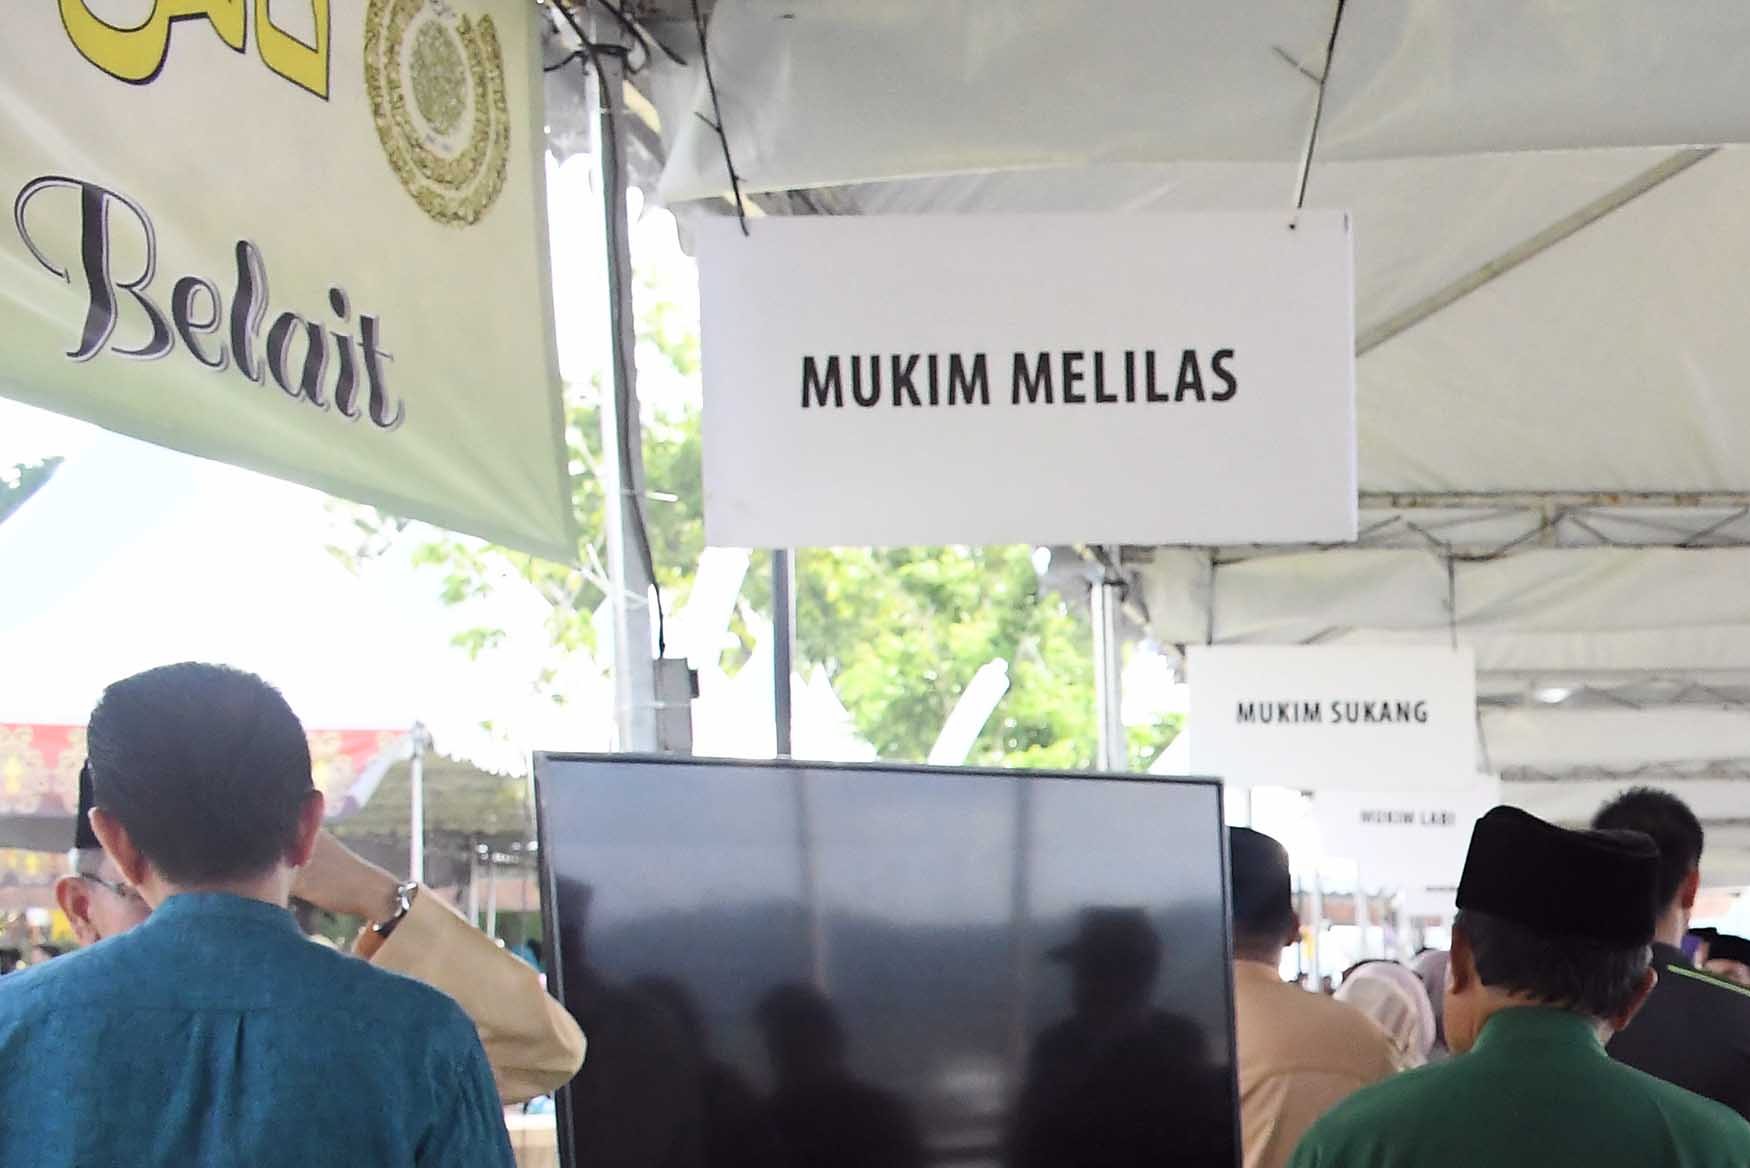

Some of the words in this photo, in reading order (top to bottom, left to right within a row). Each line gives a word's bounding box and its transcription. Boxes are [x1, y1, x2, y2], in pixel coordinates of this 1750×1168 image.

[14, 175, 403, 428] Belait
[801, 352, 990, 408] MUKIM
[1011, 348, 1238, 405] MELILAS
[1236, 701, 1323, 724] MUKIM
[1330, 700, 1428, 724] SUKANG
